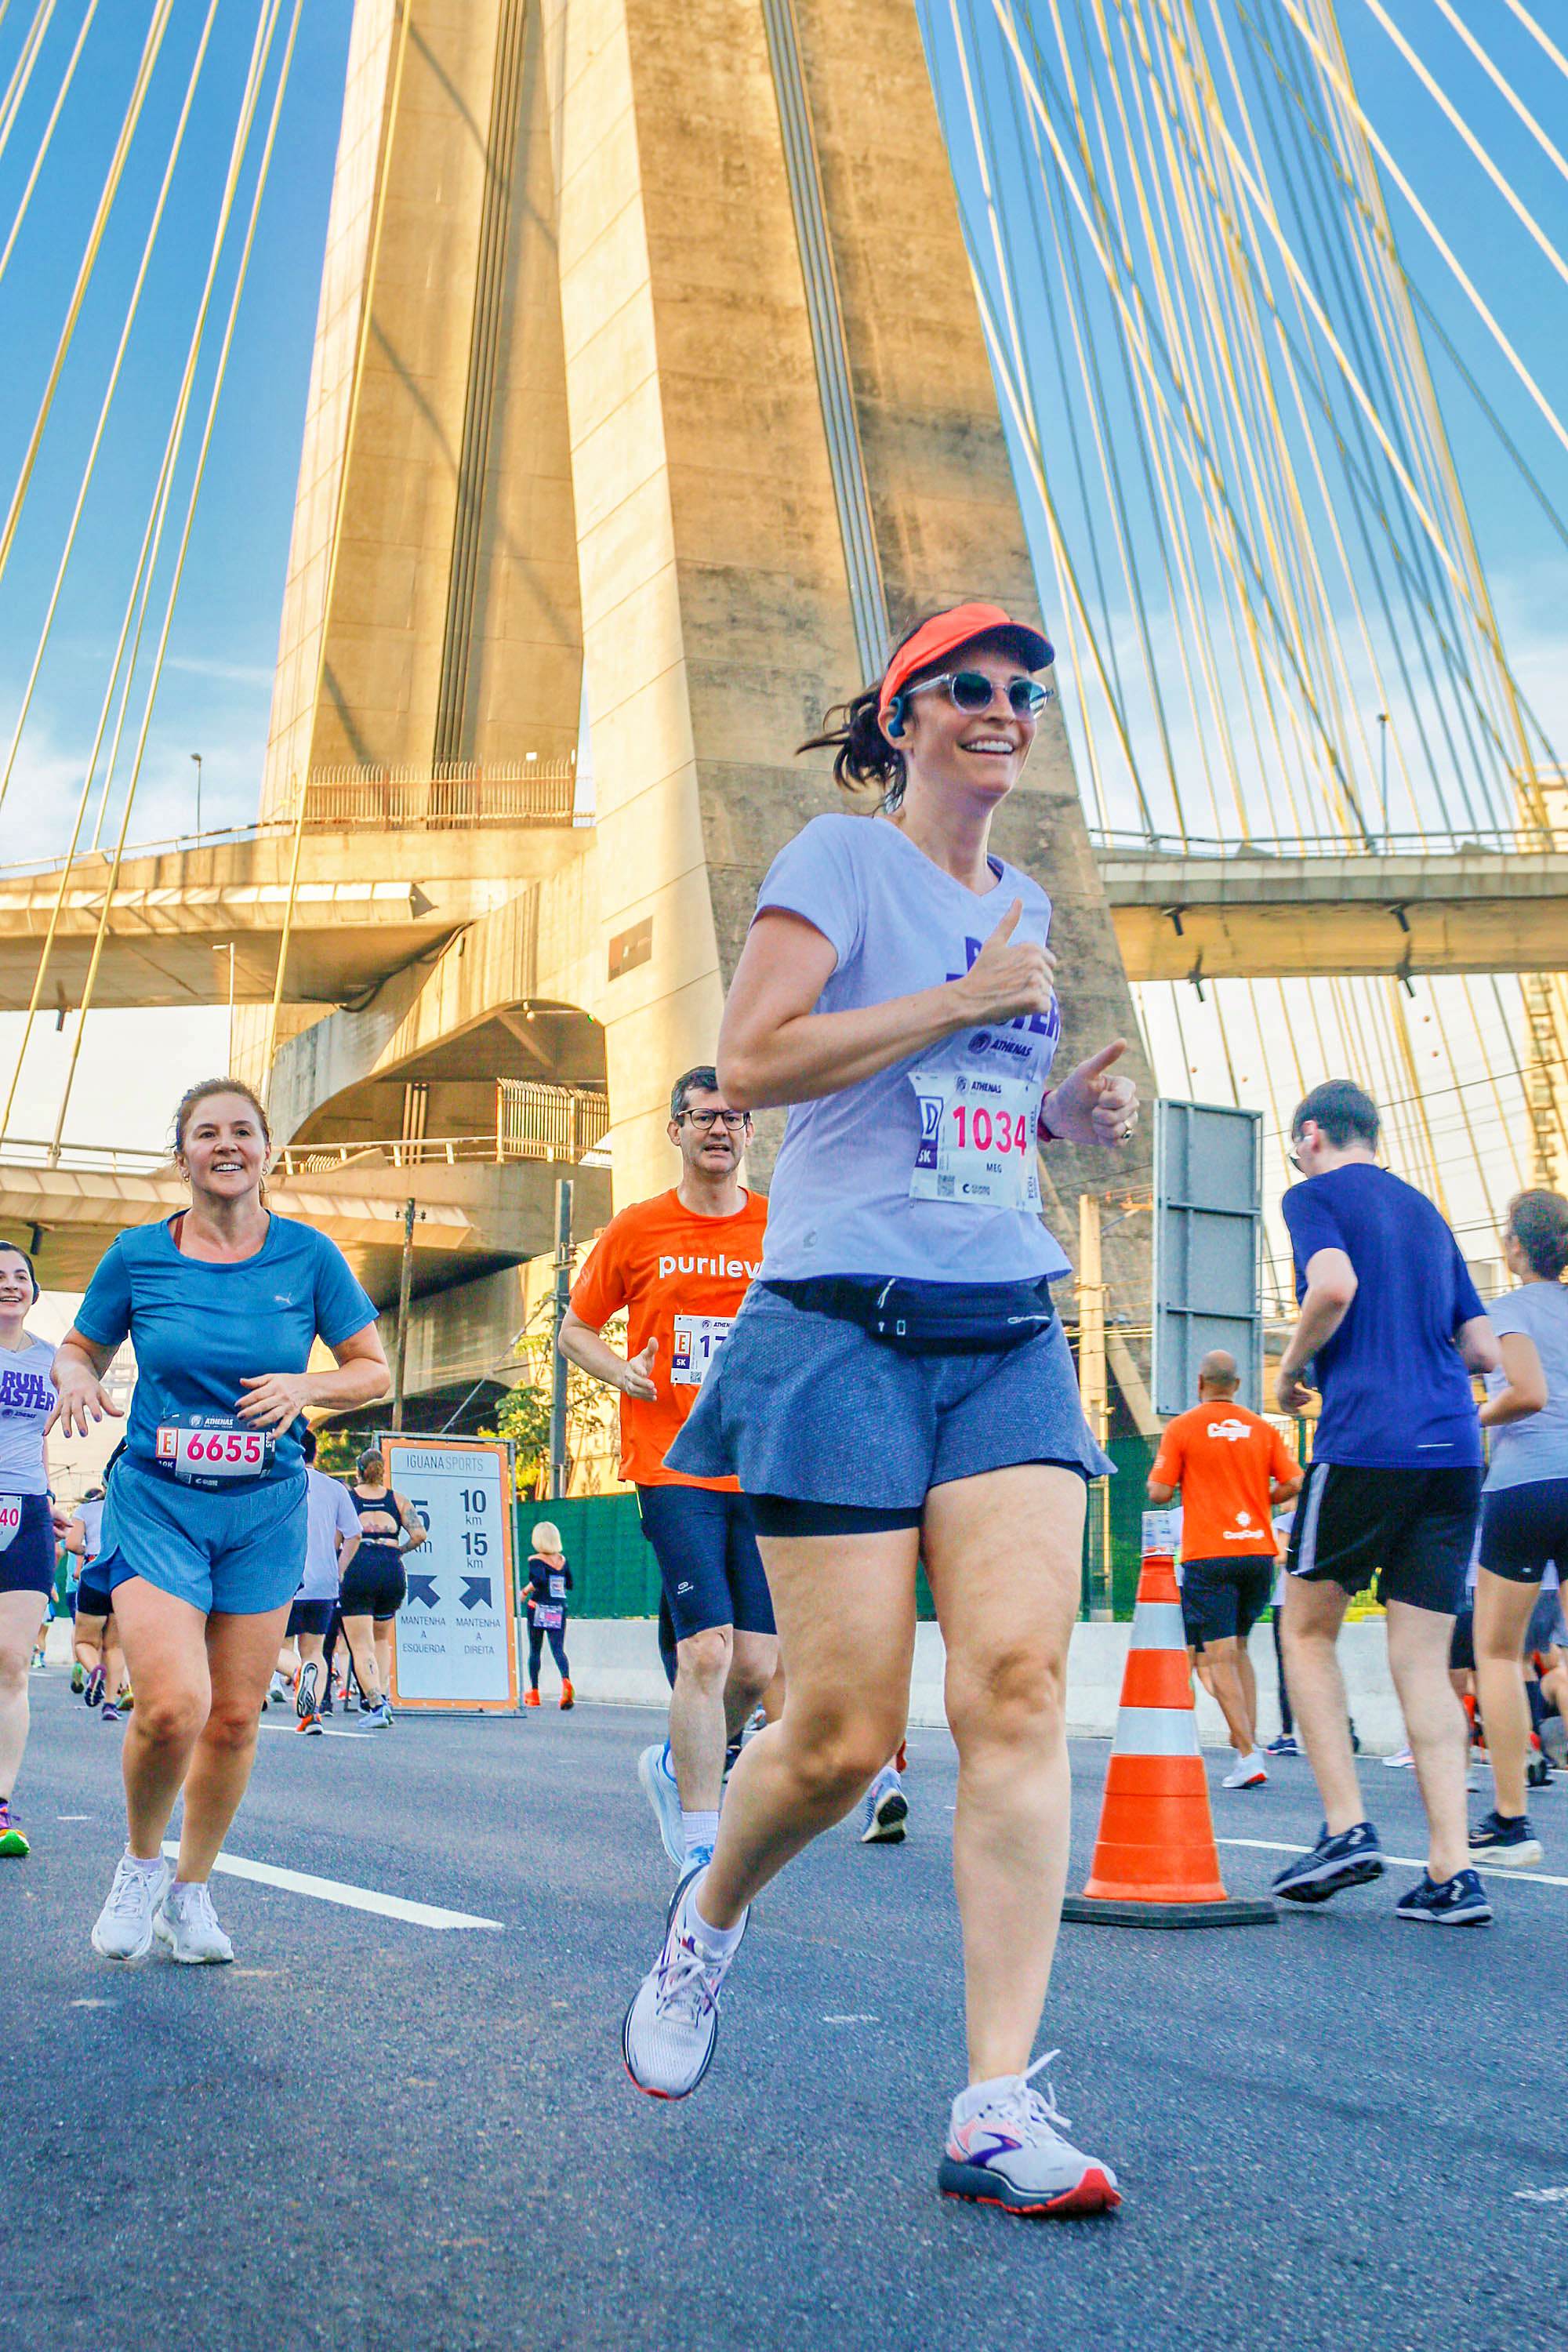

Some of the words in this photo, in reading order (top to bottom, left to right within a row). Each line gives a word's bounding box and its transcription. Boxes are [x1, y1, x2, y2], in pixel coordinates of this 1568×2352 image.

[989, 1039, 1033, 1057] ATHENAS
[971, 1081, 1001, 1094] ATHENAS
[925, 1102, 938, 1134] D
[953, 1105, 1027, 1156] 1034
[986, 1162, 1002, 1173] MEG
[679, 1334, 686, 1352] E
[2, 1370, 43, 1392] RUN
[0, 1386, 55, 1411] ASTER
[163, 1432, 172, 1453] E
[187, 1433, 260, 1463] 6655
[459, 1489, 486, 1513] 10
[0, 1508, 19, 1526] 40
[466, 1515, 482, 1525] km
[414, 1540, 432, 1553] m
[461, 1532, 488, 1555] 15
[466, 1558, 483, 1569] km
[401, 1616, 446, 1625] MANTENHA
[456, 1618, 501, 1627] MANTENHA
[464, 1646, 495, 1654] DIREITA
